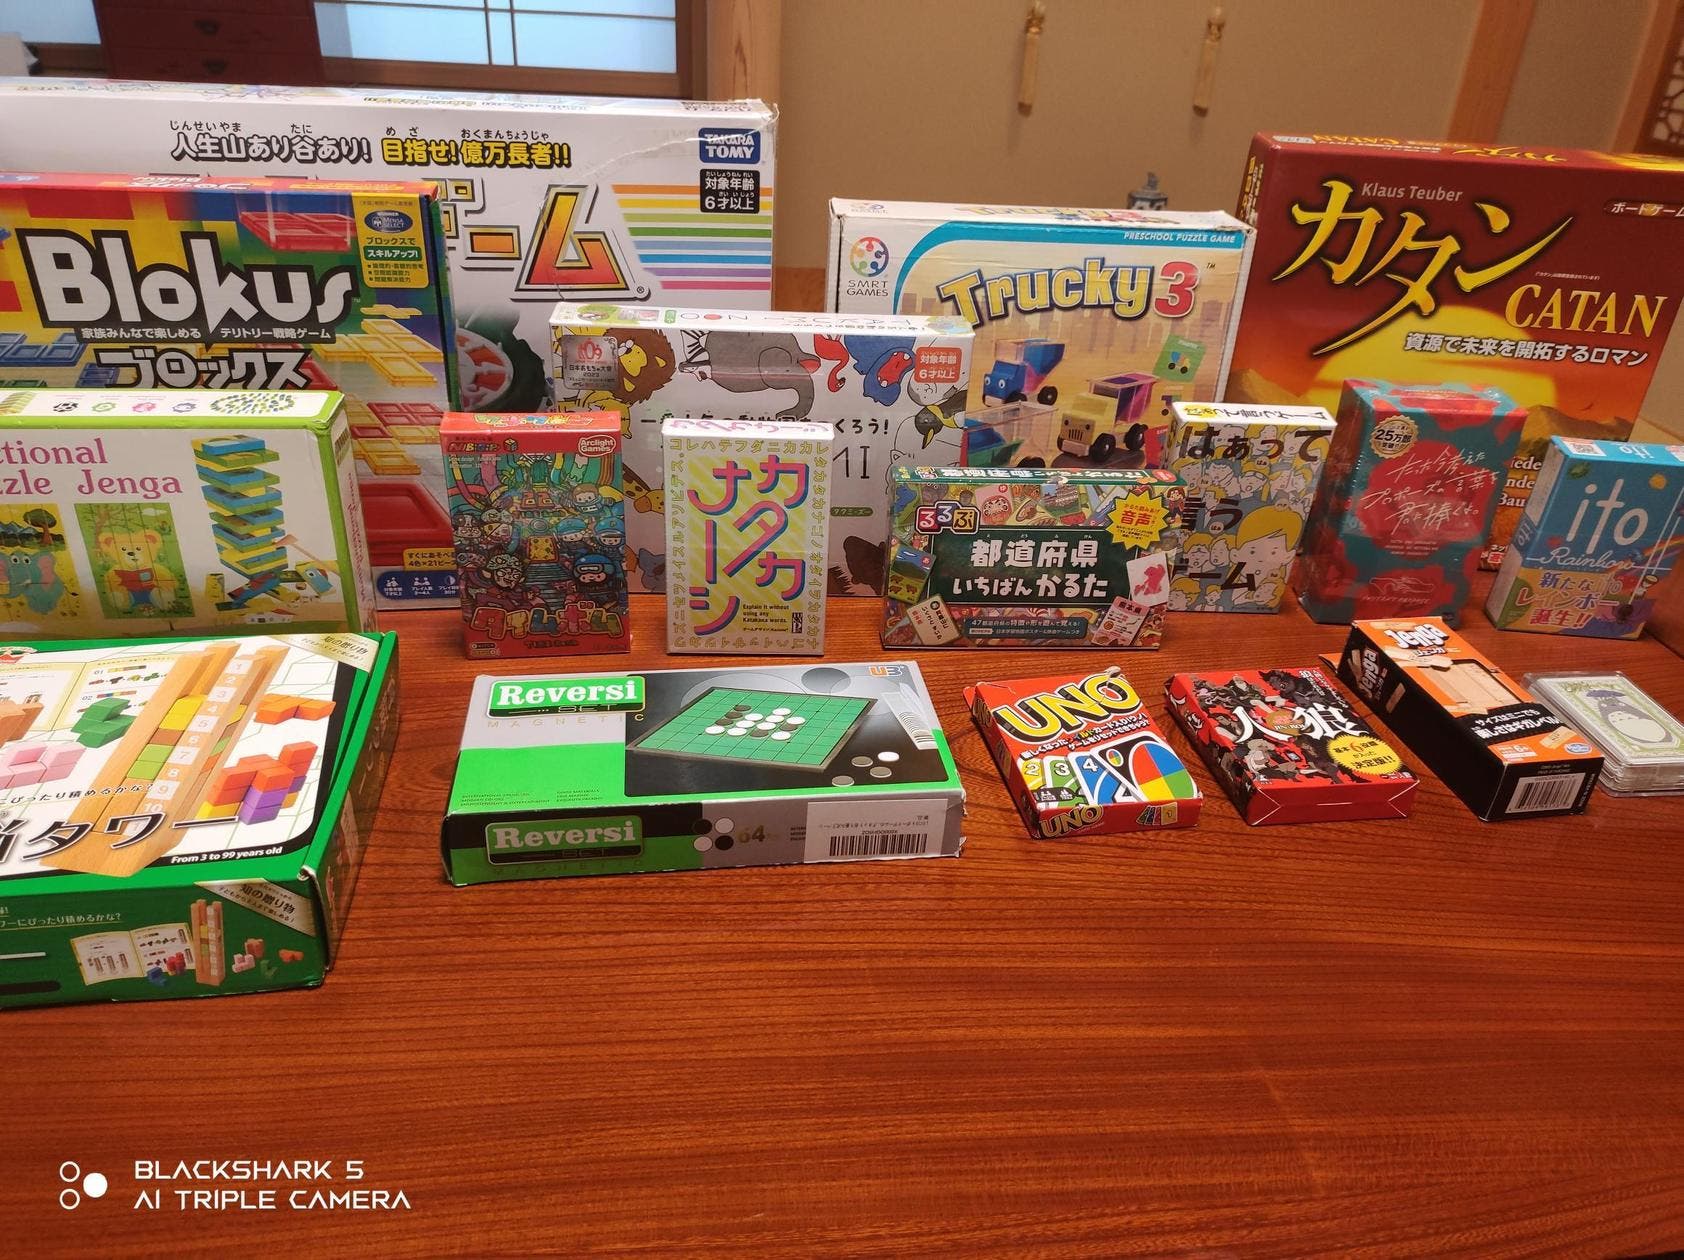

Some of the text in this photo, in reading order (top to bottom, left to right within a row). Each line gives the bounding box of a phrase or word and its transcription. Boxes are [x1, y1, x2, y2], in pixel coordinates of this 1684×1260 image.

[704, 133, 755, 145] TAKARA
[705, 145, 755, 158] TOMY
[705, 177, 755, 191] 対象年齢
[1361, 182, 1462, 201] Klaus Teuber
[704, 195, 755, 210] 6才以上
[366, 237, 416, 245] ブロックスで
[1124, 232, 1235, 243] PRESCHOOL PUZZLE GAME
[367, 249, 418, 258] スキルアップ!
[1272, 181, 1573, 356] カタン
[18, 229, 357, 333] Blokus
[848, 280, 887, 288] SMRT
[847, 288, 888, 297] GAMES
[937, 257, 1154, 329] Trucky
[1154, 261, 1200, 318] 3
[1505, 284, 1667, 337] CATAN
[81, 328, 331, 339] 家族みんなで楽しめる テリトリー戦略ゲーム
[1404, 332, 1648, 367] 資源で未来を開拓するロマン
[96, 347, 312, 389] ブロックス
[919, 369, 955, 379] 6才以上
[580, 439, 614, 448] Arclight
[1180, 426, 1332, 463] はぁって
[1375, 429, 1412, 443] 25万部
[0, 438, 108, 465] tional
[0, 470, 183, 499] zle Jenga
[917, 502, 978, 532] るるぶ
[1121, 510, 1152, 526] 音声
[1566, 479, 1649, 554] ito
[971, 539, 1098, 568] 都道府県
[1541, 547, 1634, 570] Rainbow
[1539, 572, 1593, 591] 新たな
[1384, 624, 1449, 649] Jenga
[1359, 649, 1379, 699] Jenga
[497, 680, 638, 706] Reversi
[993, 673, 1143, 743] UNO
[1024, 763, 1039, 775] 2
[1055, 762, 1070, 775] 3
[1082, 758, 1098, 772] 4
[1040, 805, 1104, 838] UNO
[494, 821, 635, 848] Reversi
[171, 846, 283, 864] From 3 to 99 years old
